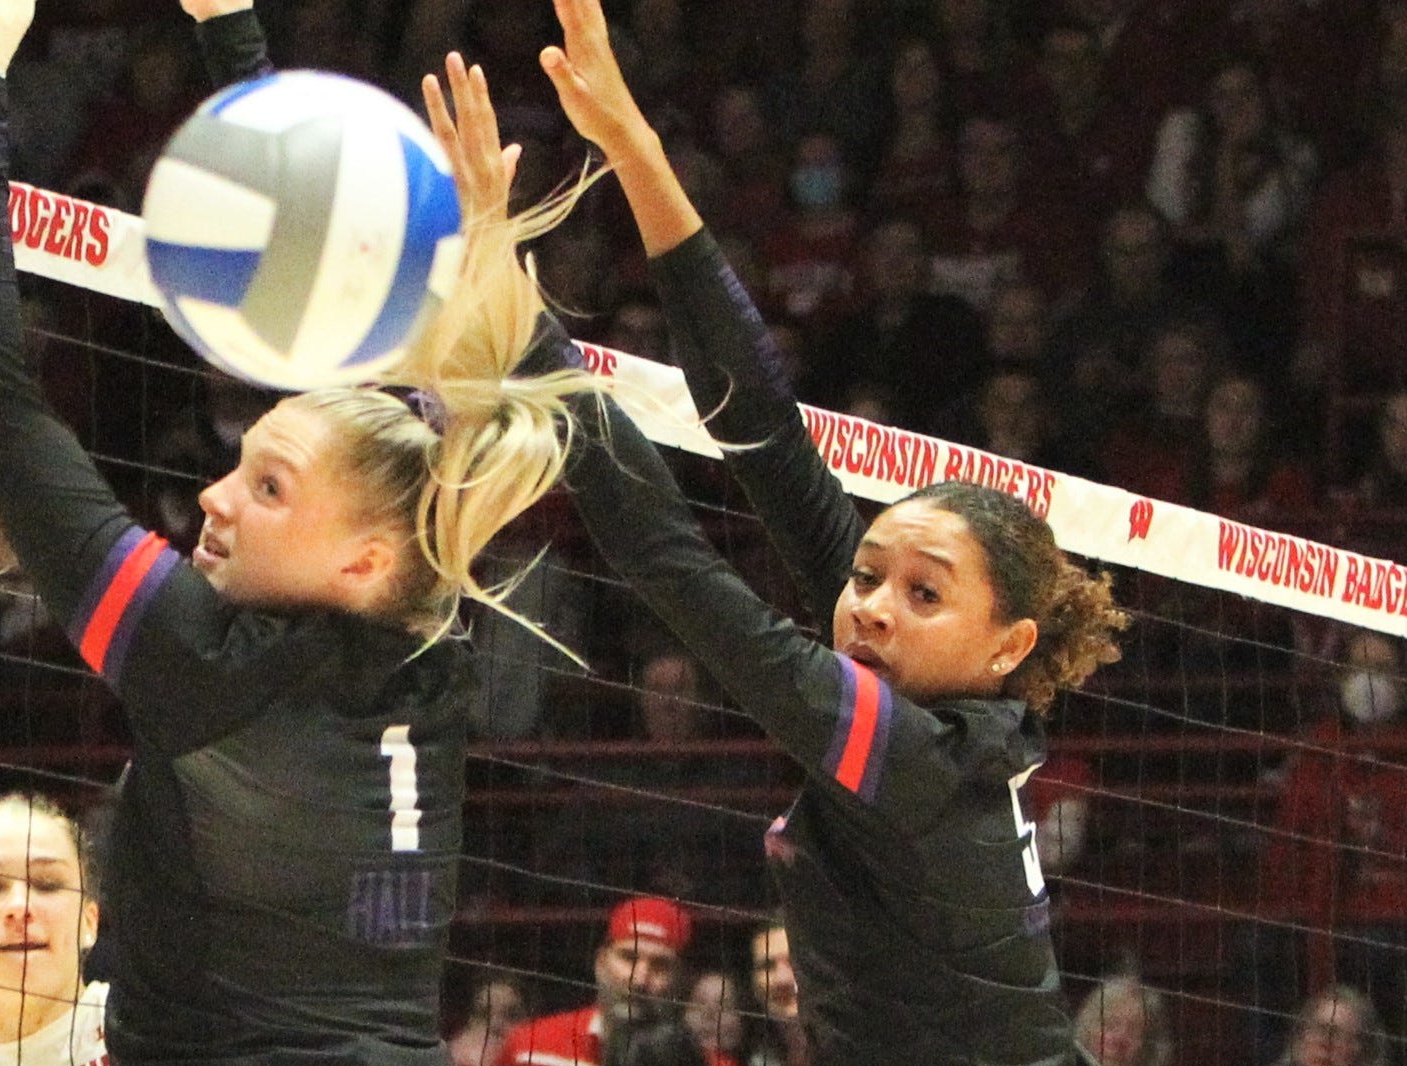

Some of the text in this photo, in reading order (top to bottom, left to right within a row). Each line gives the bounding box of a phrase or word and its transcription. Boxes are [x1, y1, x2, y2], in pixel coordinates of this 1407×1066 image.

[7, 184, 110, 267] DGERS
[804, 408, 939, 489] WISCONSIN
[1217, 520, 1407, 617] WISCONSIN BADG
[380, 725, 424, 853] 1
